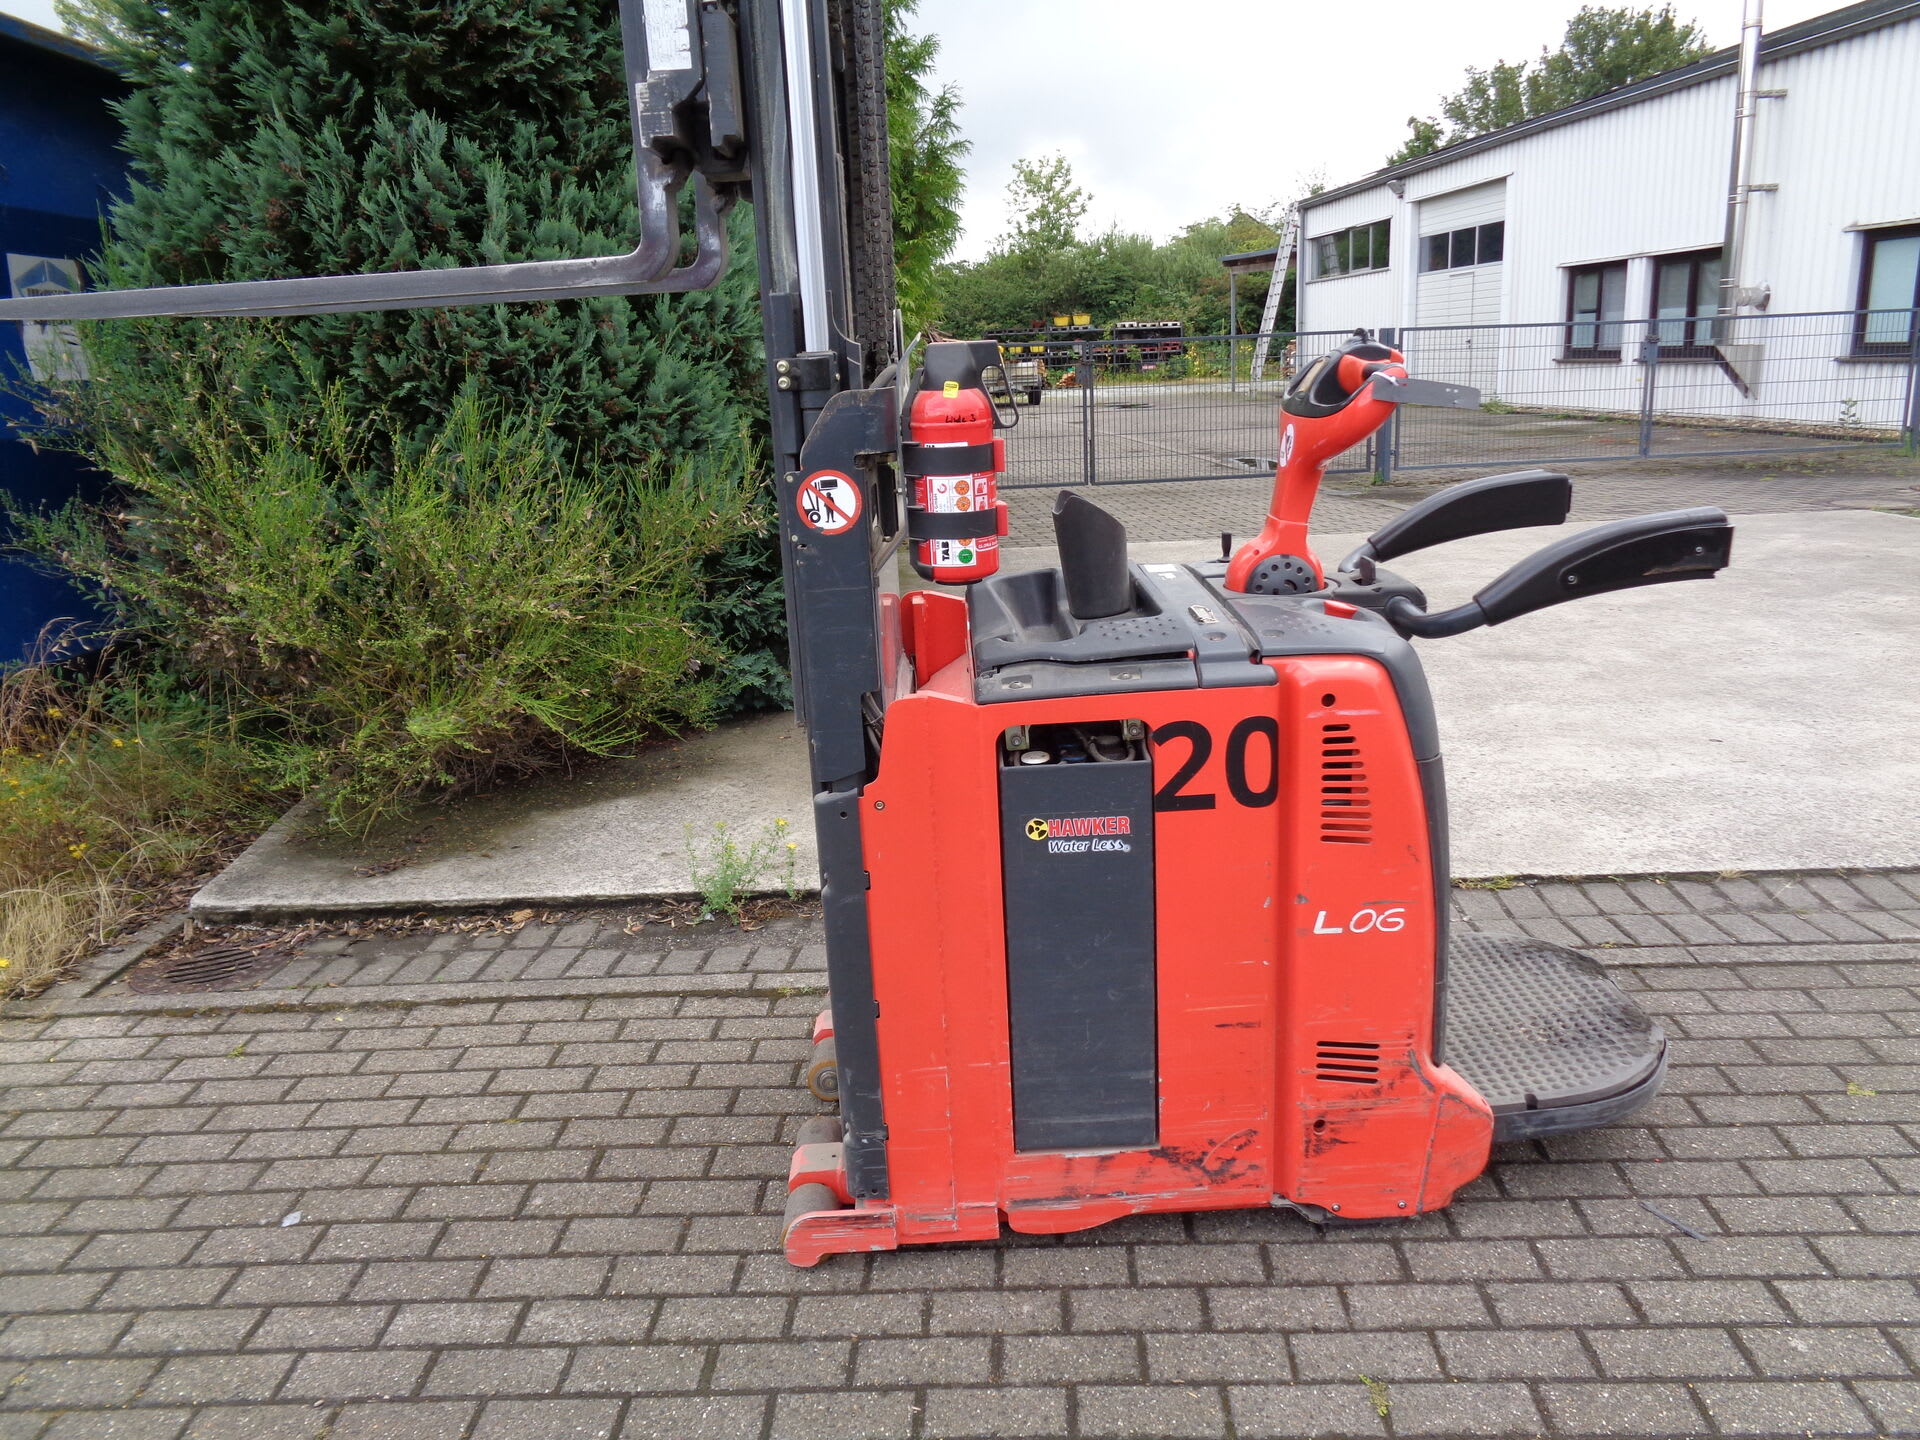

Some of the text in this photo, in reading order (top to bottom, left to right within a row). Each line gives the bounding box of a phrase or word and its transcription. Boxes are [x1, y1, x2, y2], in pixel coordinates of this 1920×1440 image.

[941, 541, 950, 561] TAB
[1151, 715, 1279, 813] 20
[1047, 816, 1130, 838] HAWKER
[1047, 839, 1090, 853] Water
